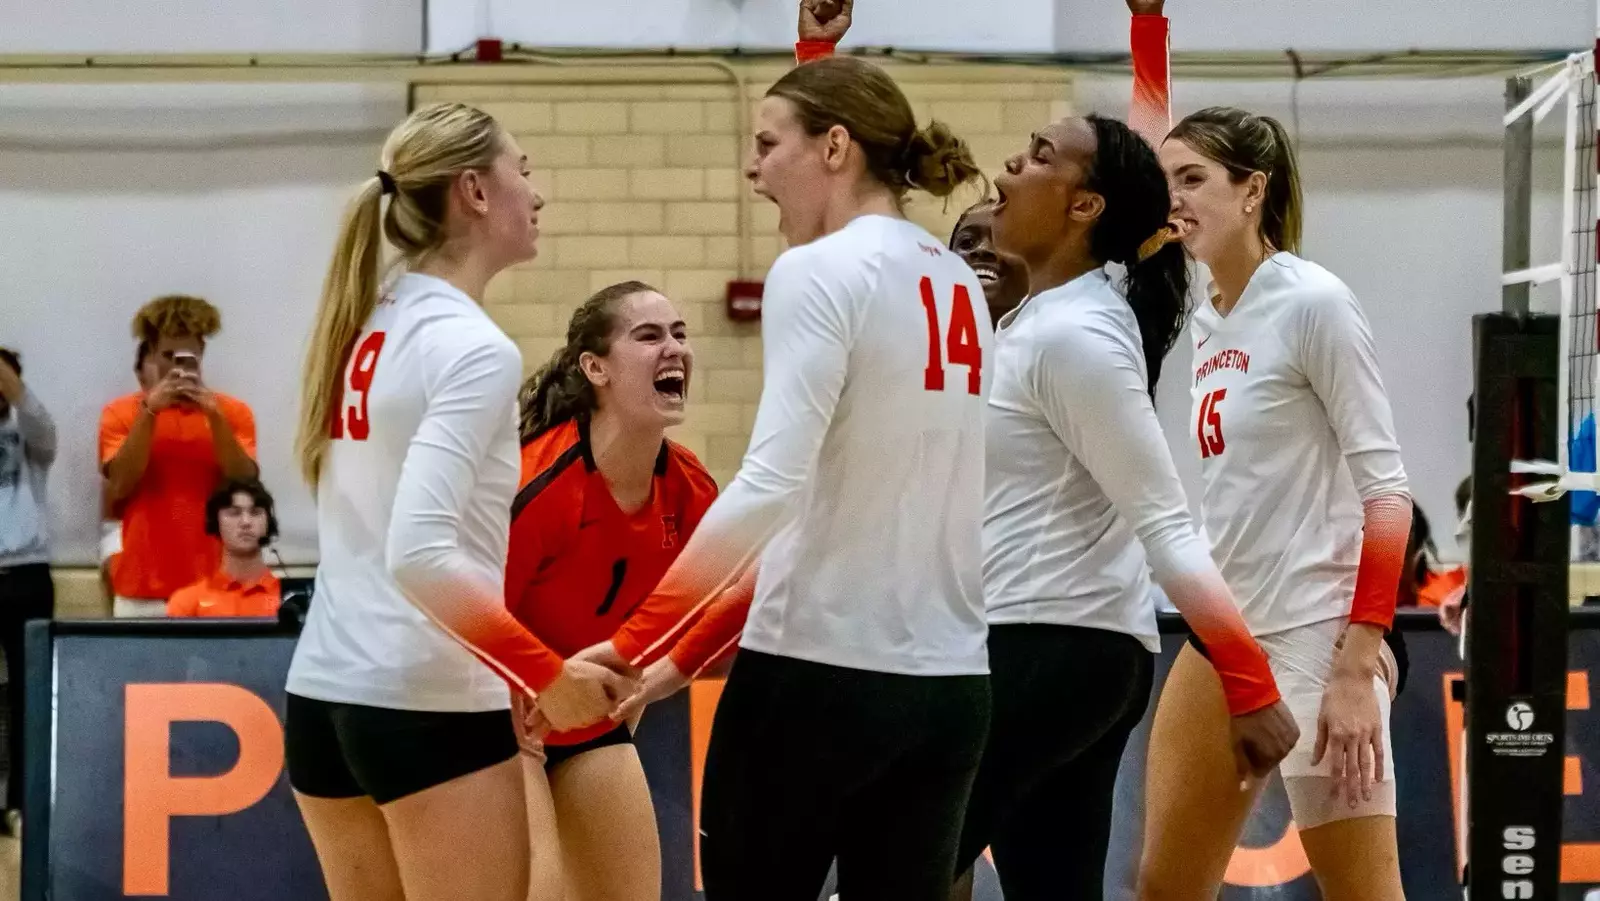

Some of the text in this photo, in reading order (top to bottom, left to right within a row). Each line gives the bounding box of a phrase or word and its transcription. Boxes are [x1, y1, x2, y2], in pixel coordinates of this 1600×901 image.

[919, 275, 982, 397] 14
[1195, 348, 1250, 389] PRINCETON
[1197, 387, 1227, 459] 15
[595, 557, 627, 616] 1
[1485, 732, 1517, 744] SPORTS
